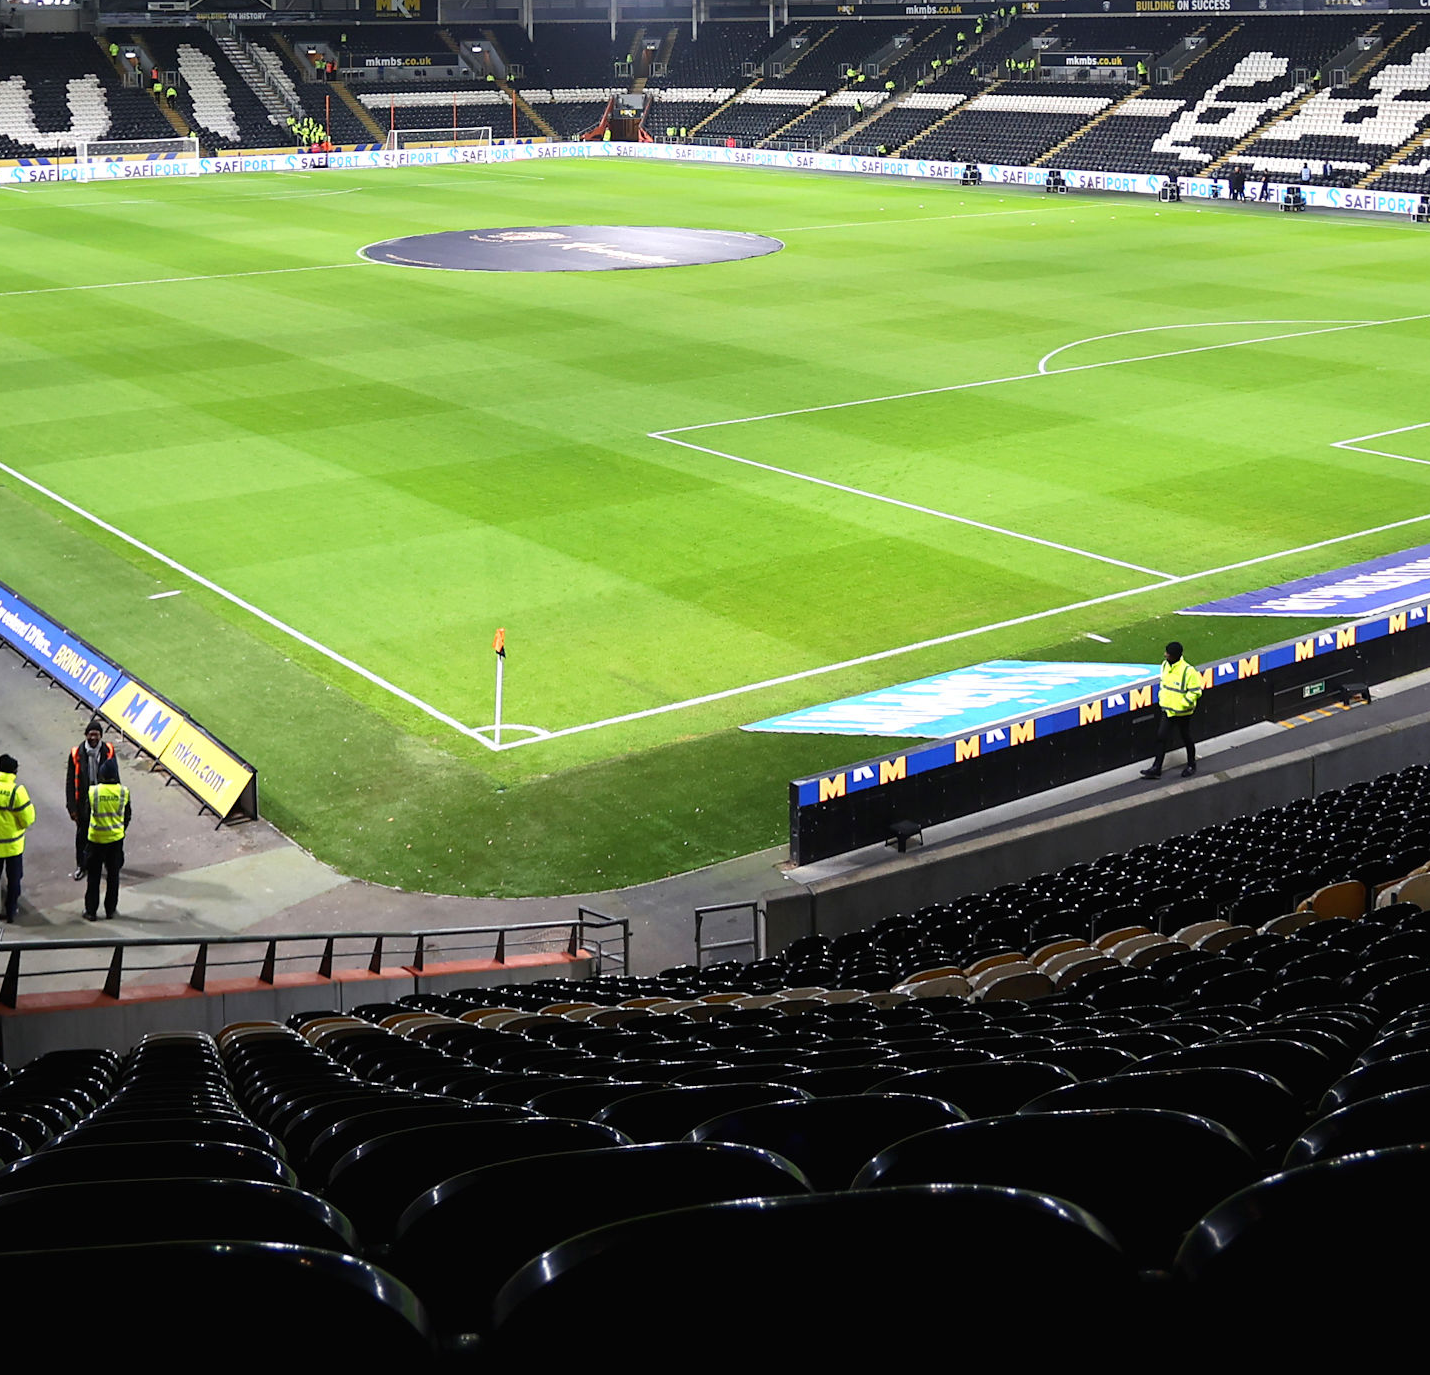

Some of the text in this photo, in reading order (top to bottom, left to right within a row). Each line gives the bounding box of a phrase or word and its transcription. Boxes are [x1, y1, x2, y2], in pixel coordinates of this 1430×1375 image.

[906, 3, 962, 15] mkmbs.co.uk
[1022, 3, 1039, 14] MKM
[1136, 0, 1231, 12] BUILDING ON SUCCESS
[239, 12, 266, 21] HISTORY
[365, 55, 432, 67] mkmbs.co.uk
[1066, 54, 1123, 67] mkmbs.co.uk
[52, 644, 88, 678] BRING
[89, 671, 112, 700] ON.
[123, 694, 171, 741] MM
[173, 741, 226, 792] mkm.com
